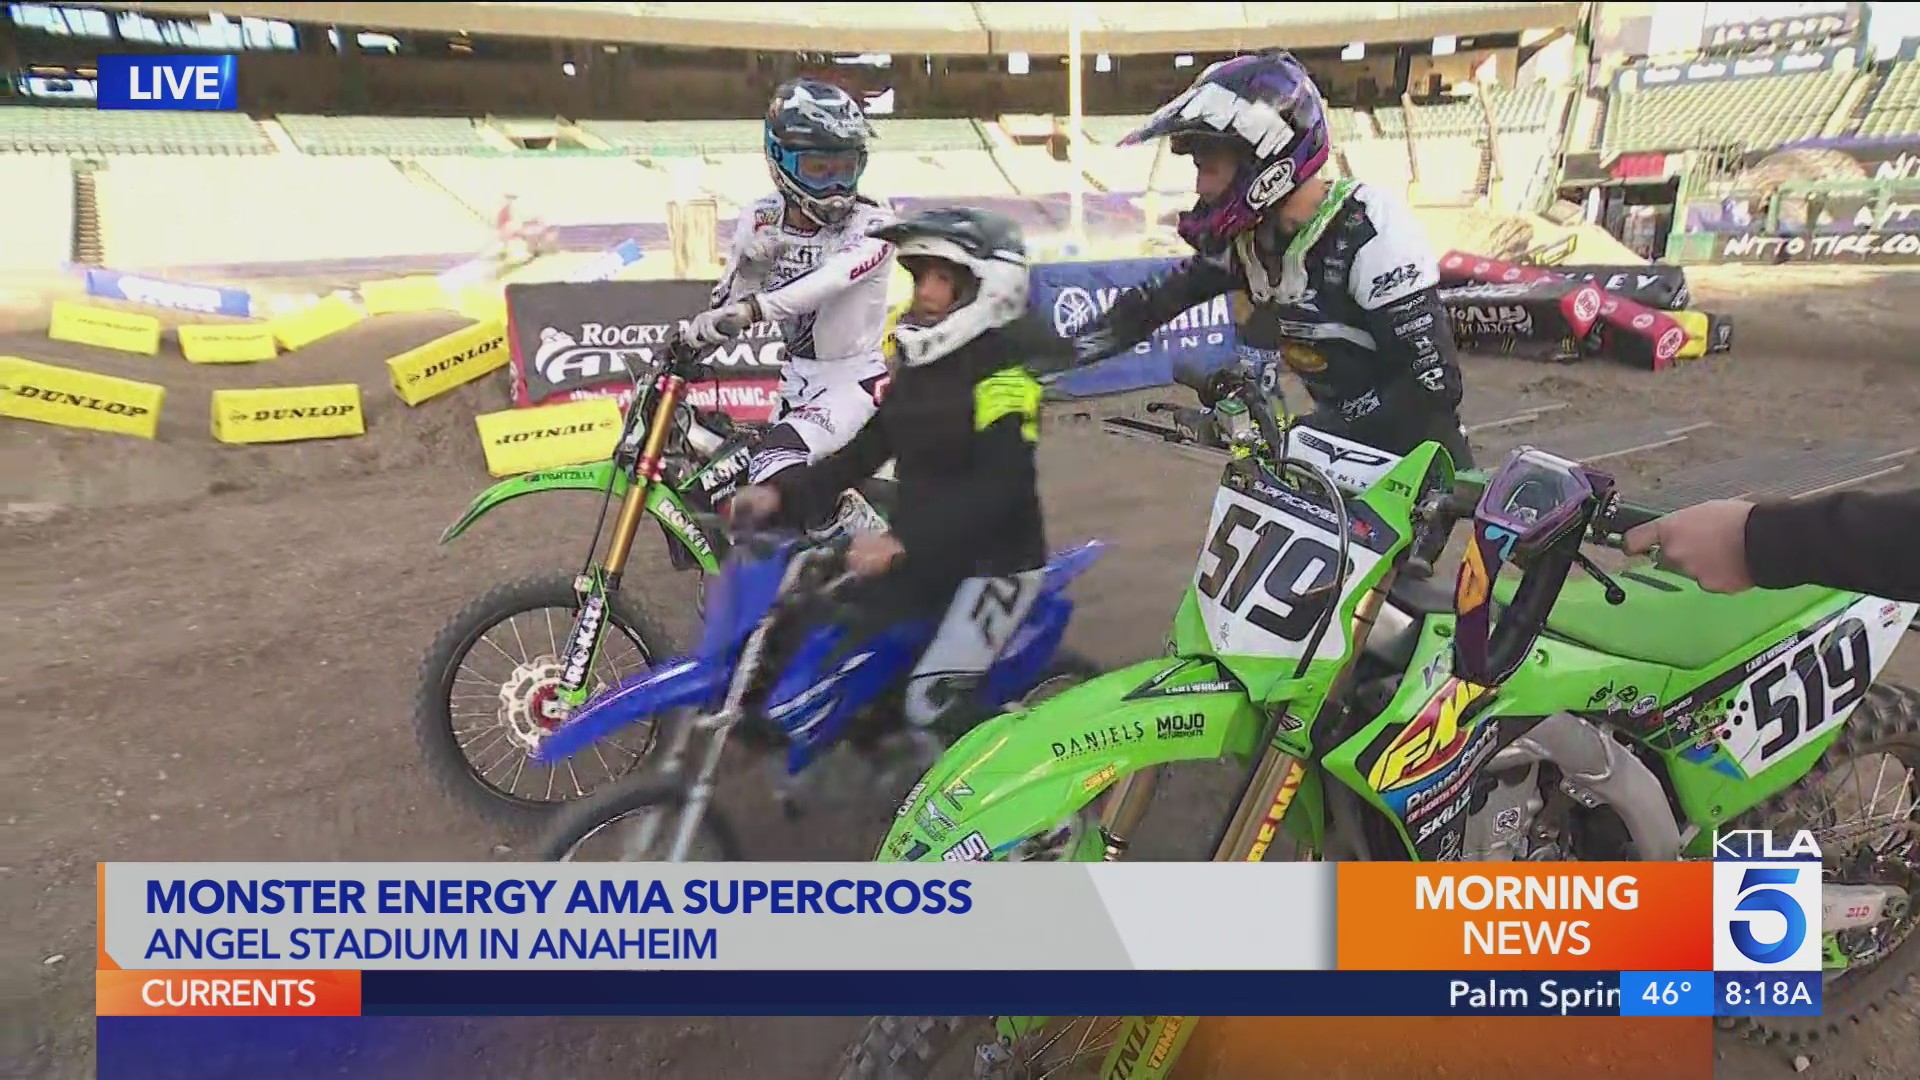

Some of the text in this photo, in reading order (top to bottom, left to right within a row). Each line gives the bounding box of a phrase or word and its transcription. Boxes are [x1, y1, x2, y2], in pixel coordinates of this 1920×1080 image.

[580, 322, 672, 347] ROCKY
[1133, 332, 1225, 355] CING
[422, 336, 504, 379] DUNLOP
[16, 384, 150, 418] DUNLOP
[251, 404, 355, 423] DUNLOP
[494, 422, 594, 446] DUNLOP
[1198, 503, 1355, 642] 519
[1750, 616, 1872, 761] 519
[1156, 712, 1206, 733] MOJO
[1051, 720, 1145, 758] DANIELS
